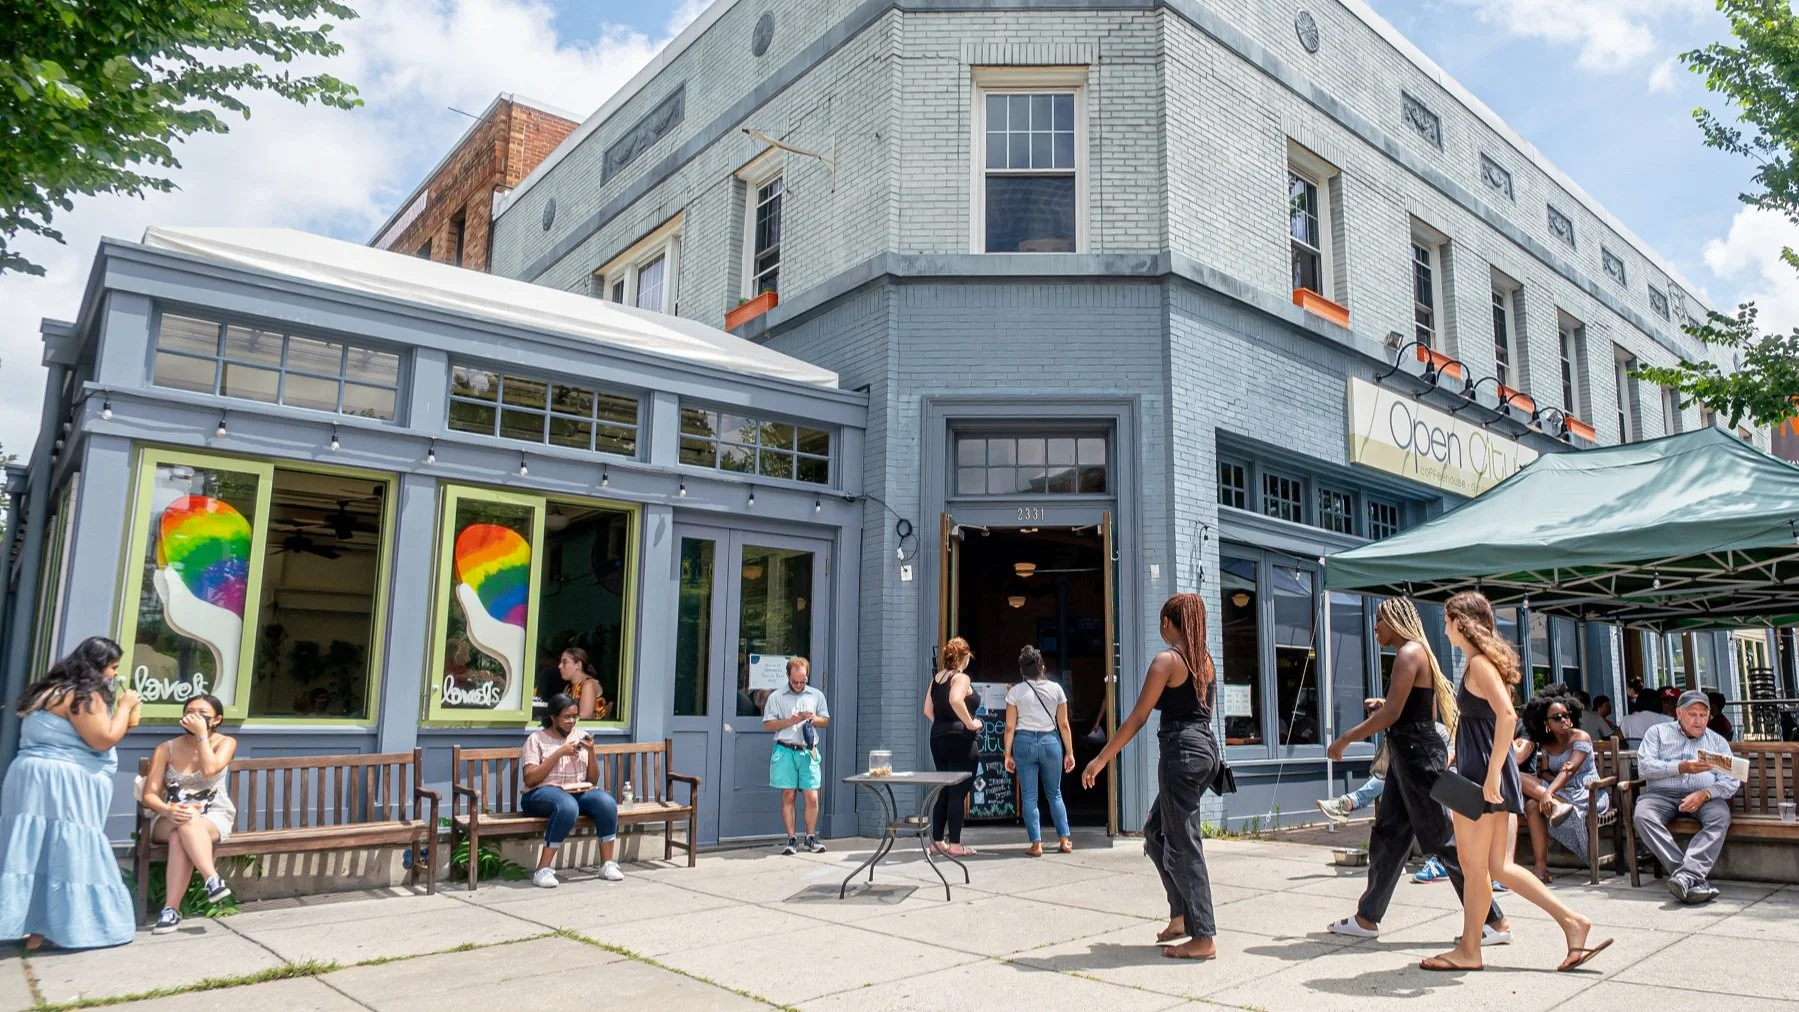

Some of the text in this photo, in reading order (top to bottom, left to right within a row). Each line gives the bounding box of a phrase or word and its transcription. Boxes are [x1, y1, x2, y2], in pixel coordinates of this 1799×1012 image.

[1389, 400, 1462, 474] Open
[1017, 507, 1044, 521] 2331
[976, 716, 1006, 738] Ope
